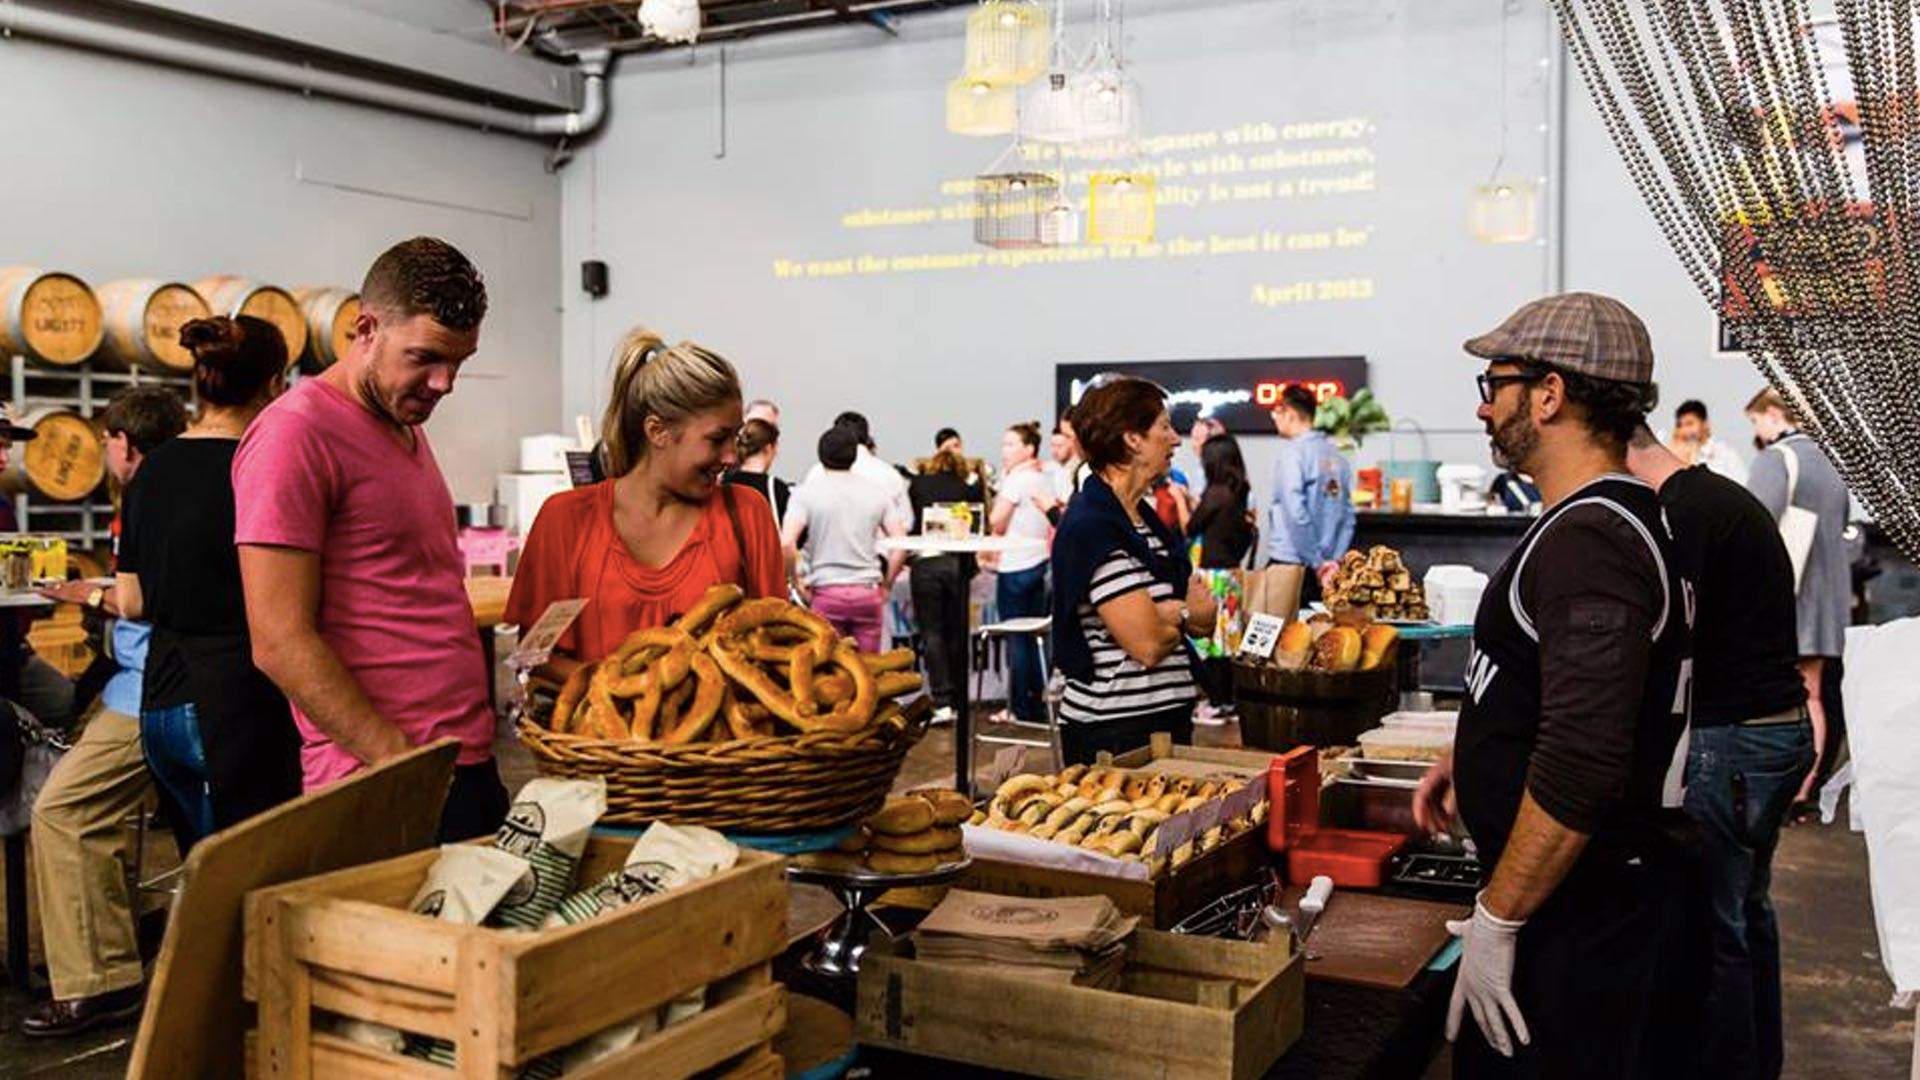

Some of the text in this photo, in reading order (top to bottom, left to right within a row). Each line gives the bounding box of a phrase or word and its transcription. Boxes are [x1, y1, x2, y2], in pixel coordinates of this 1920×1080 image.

[1222, 122, 1277, 146] with
[1191, 153, 1245, 175] with
[1209, 180, 1230, 201] is
[1233, 179, 1273, 200] not
[1277, 181, 1295, 197] a
[774, 259, 803, 278] We
[807, 258, 853, 277] want
[857, 254, 888, 273] the
[892, 252, 983, 271] customer
[1167, 236, 1206, 257] the
[1209, 234, 1258, 255] best
[1263, 230, 1282, 251] it
[1286, 233, 1331, 251] can
[1250, 278, 1375, 307] April 2013
